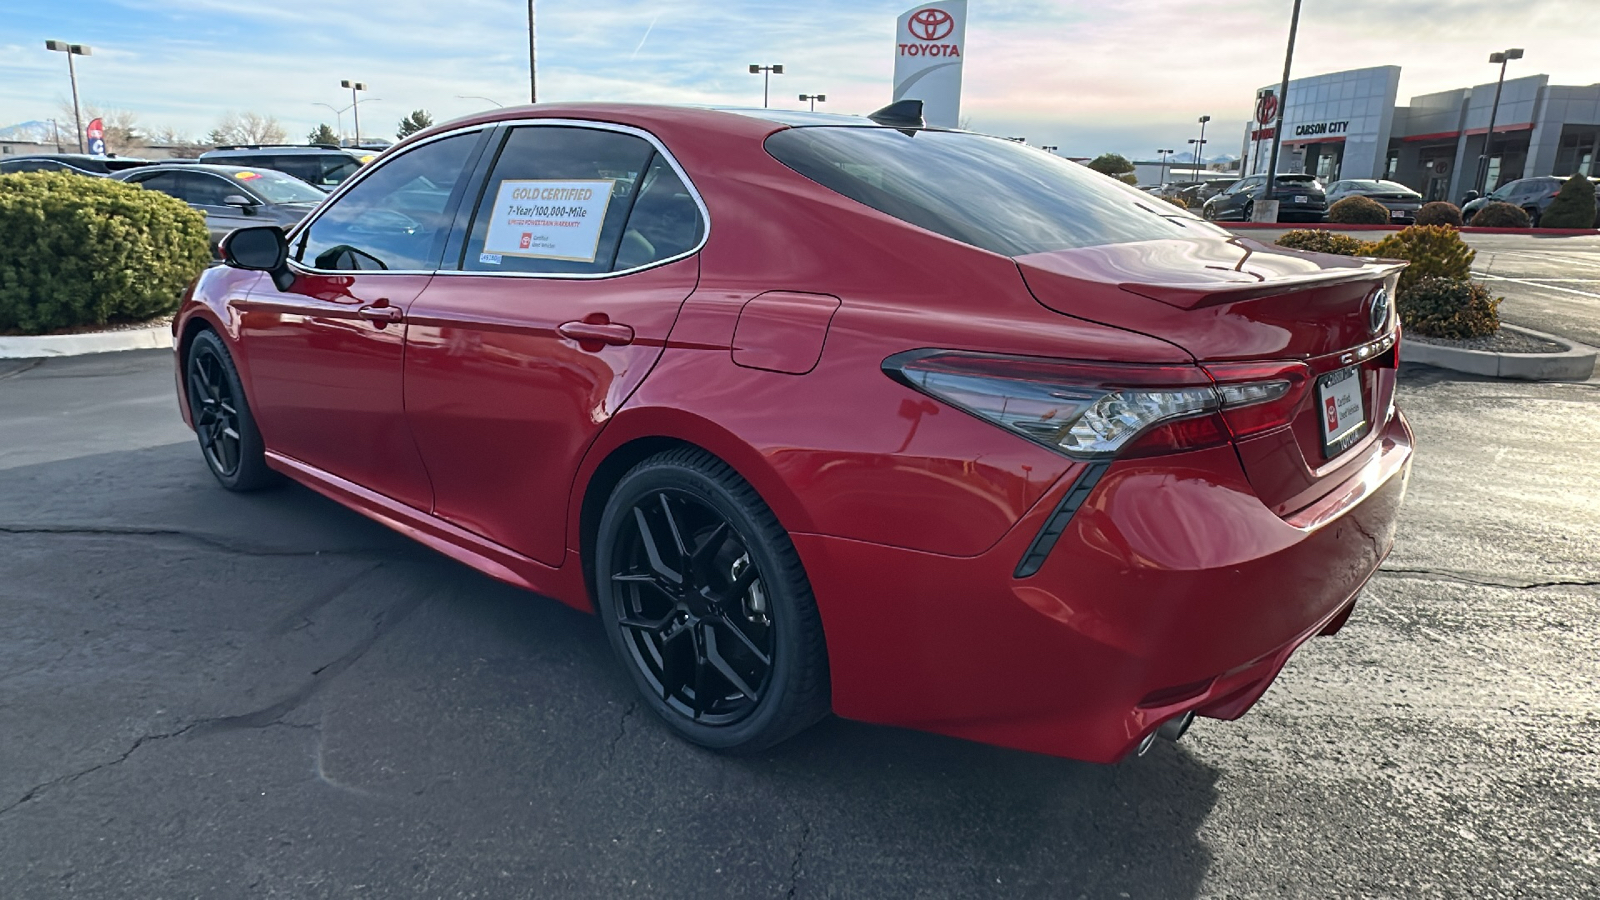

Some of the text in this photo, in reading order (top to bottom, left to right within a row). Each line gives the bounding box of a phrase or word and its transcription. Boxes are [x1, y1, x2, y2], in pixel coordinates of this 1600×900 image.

[899, 43, 960, 57] TOYOTA
[1296, 121, 1349, 136] CARSON CITY
[512, 187, 593, 201] GOLD CERTIFIED
[507, 205, 587, 218] 7-Year/100,000-Mile
